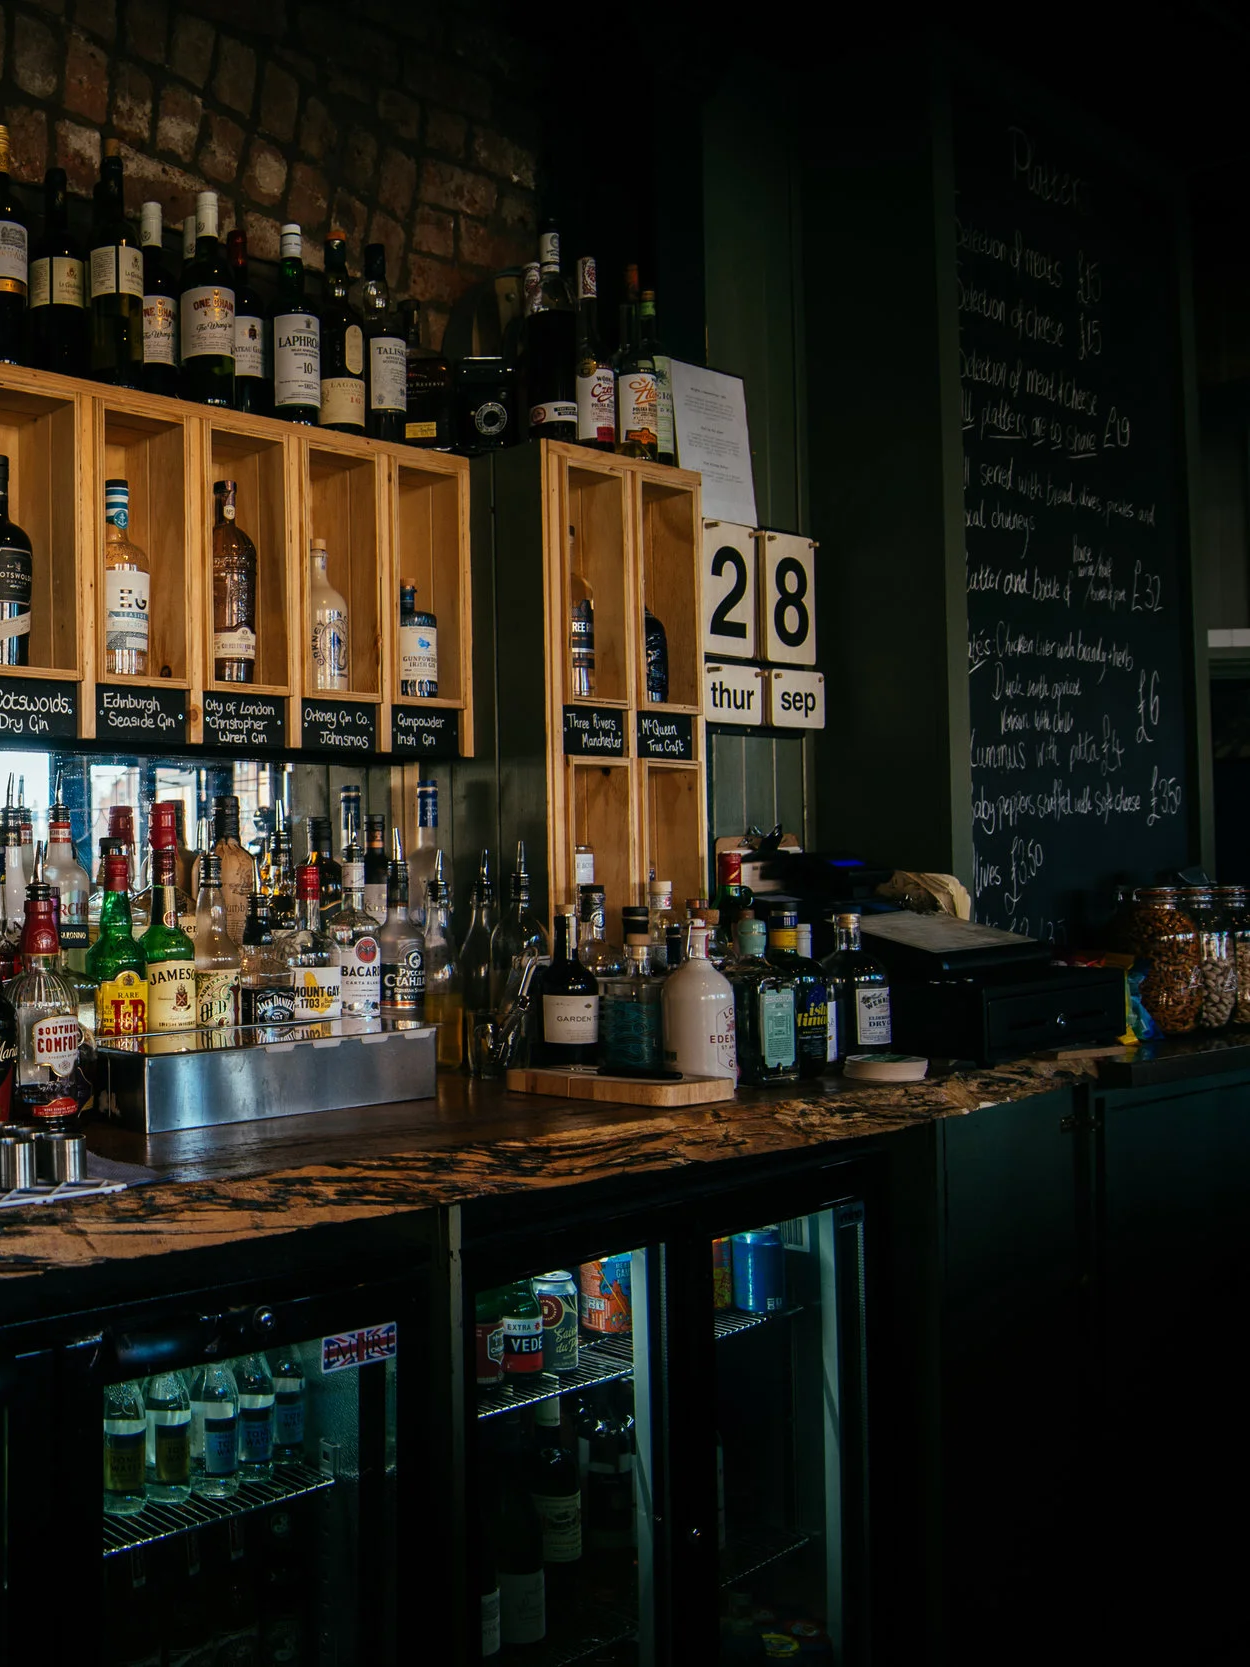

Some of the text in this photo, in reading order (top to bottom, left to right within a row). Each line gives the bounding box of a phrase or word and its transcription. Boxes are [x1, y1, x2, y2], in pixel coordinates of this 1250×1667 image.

[193, 298, 211, 311] ONE
[303, 362, 313, 374] 10
[1103, 406, 1131, 448] £19
[1131, 560, 1164, 612] £32
[103, 692, 161, 714] Edinburgh
[205, 699, 275, 717] City of London
[711, 681, 816, 718] thur sep
[1136, 668, 1161, 743] £6
[28, 714, 49, 734] Gin
[108, 712, 176, 731] Seaside Gin
[209, 716, 268, 735] Christopher
[304, 708, 337, 730] Orkney
[338, 710, 352, 726] Gin
[397, 713, 445, 729] Gunpowder
[566, 712, 616, 730] Three Rivers
[218, 731, 268, 745] Wren Gin
[320, 731, 369, 749] Johnsmas
[398, 733, 436, 747] Irish Gin
[582, 732, 622, 749] Manchester
[647, 739, 684, 753] True Craft
[117, 991, 140, 999] RARE
[327, 985, 340, 996] GAY
[257, 999, 273, 1015] JACK
[300, 999, 320, 1009] 1703
[557, 1015, 591, 1023] GARDEN
[507, 1324, 531, 1332] EXTRA
